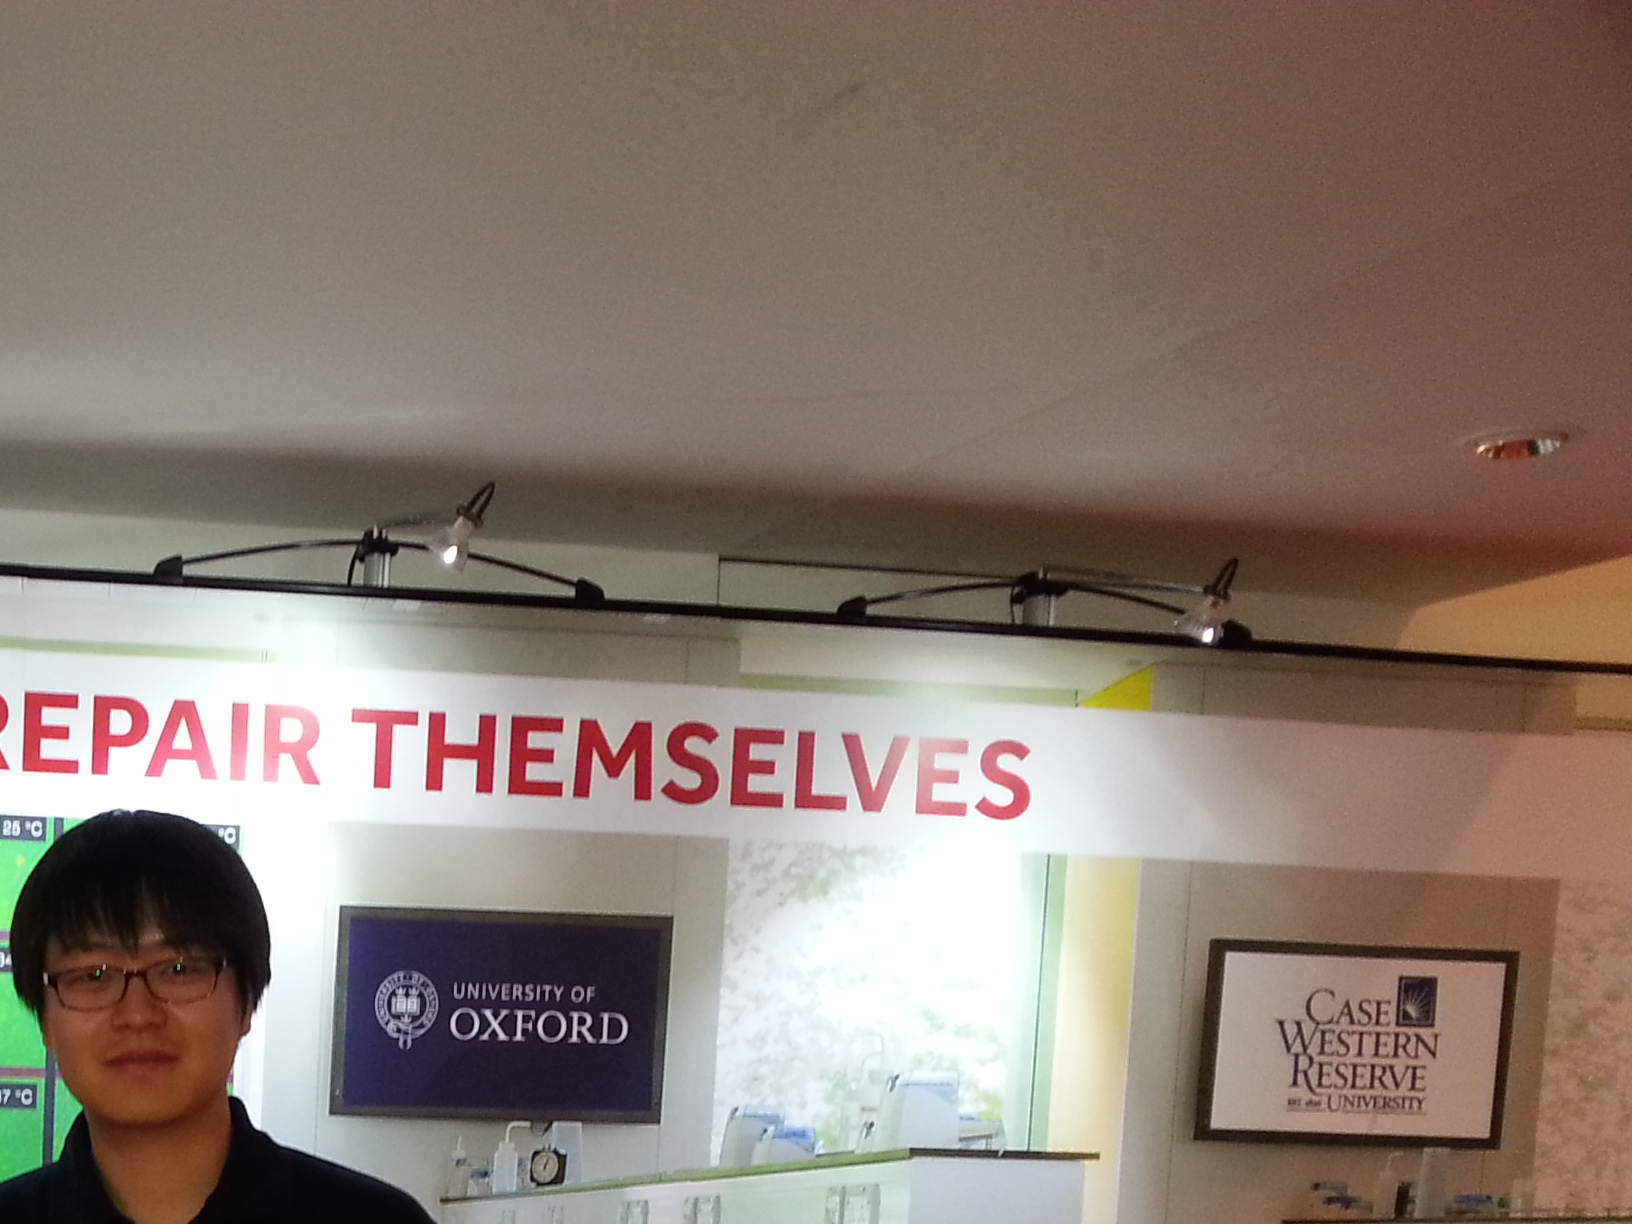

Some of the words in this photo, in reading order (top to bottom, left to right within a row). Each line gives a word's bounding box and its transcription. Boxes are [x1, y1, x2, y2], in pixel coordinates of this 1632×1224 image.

[351, 707, 1032, 822] THEMSELVES
[453, 981, 564, 1003] UNIVERSITY
[570, 985, 596, 1003] OF
[449, 1006, 630, 1045] OXFORD
